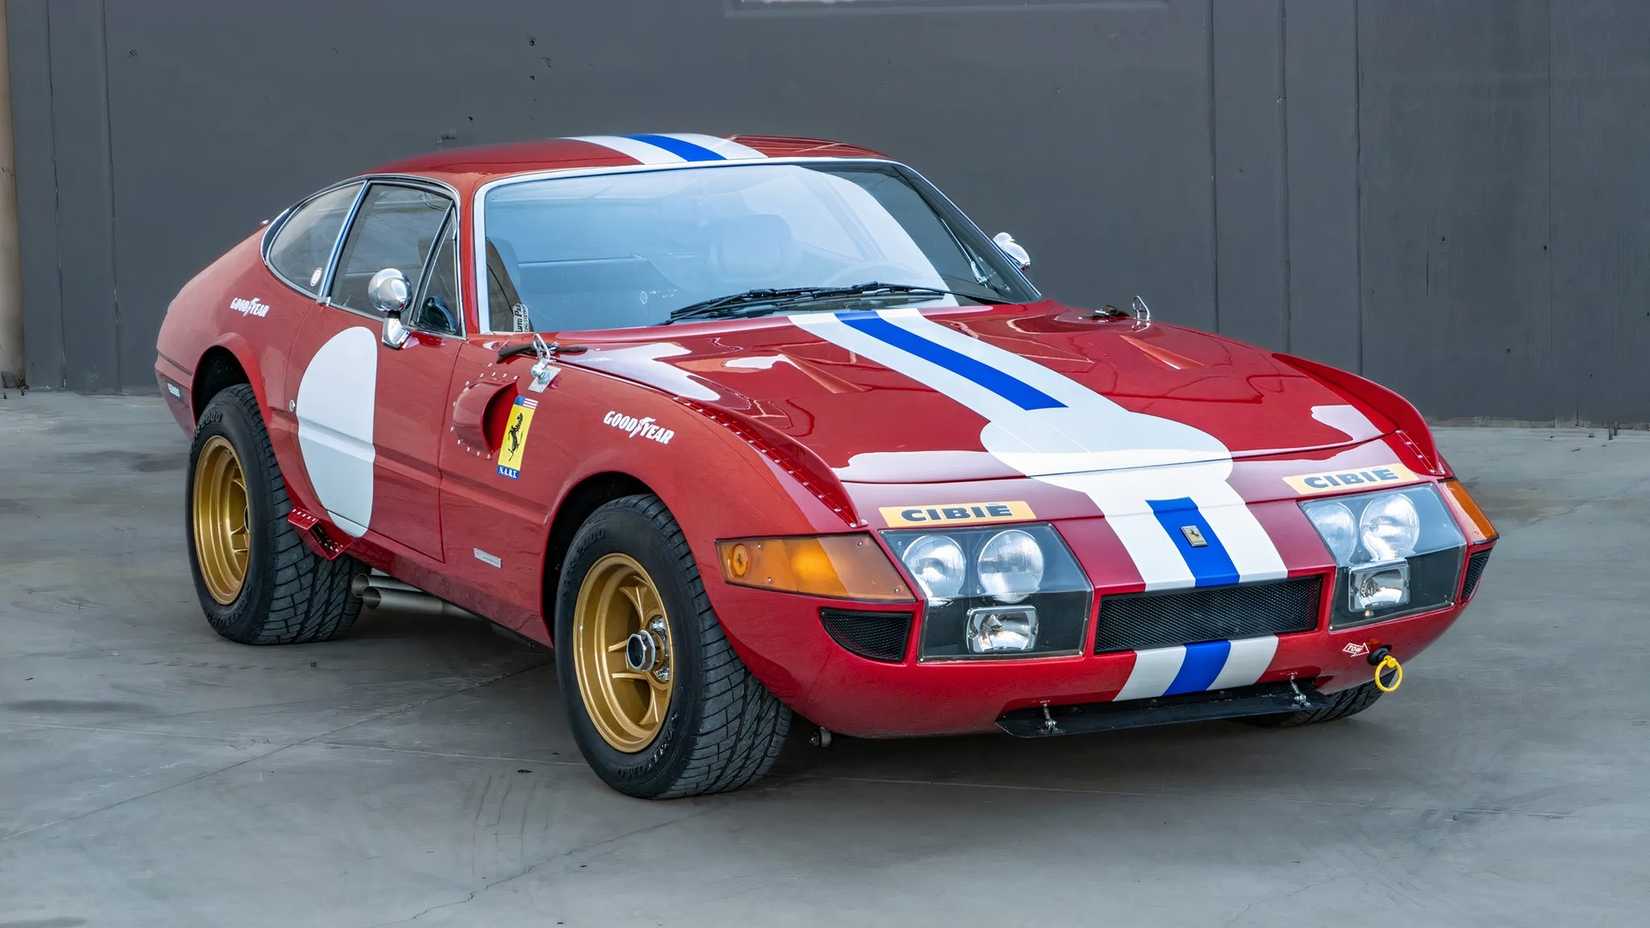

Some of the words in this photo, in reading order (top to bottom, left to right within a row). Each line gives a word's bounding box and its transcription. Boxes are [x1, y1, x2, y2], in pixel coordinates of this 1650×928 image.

[603, 410, 675, 445] GOODYEAR
[1303, 469, 1399, 488] CIBIE
[901, 504, 1013, 521] CIBIE
